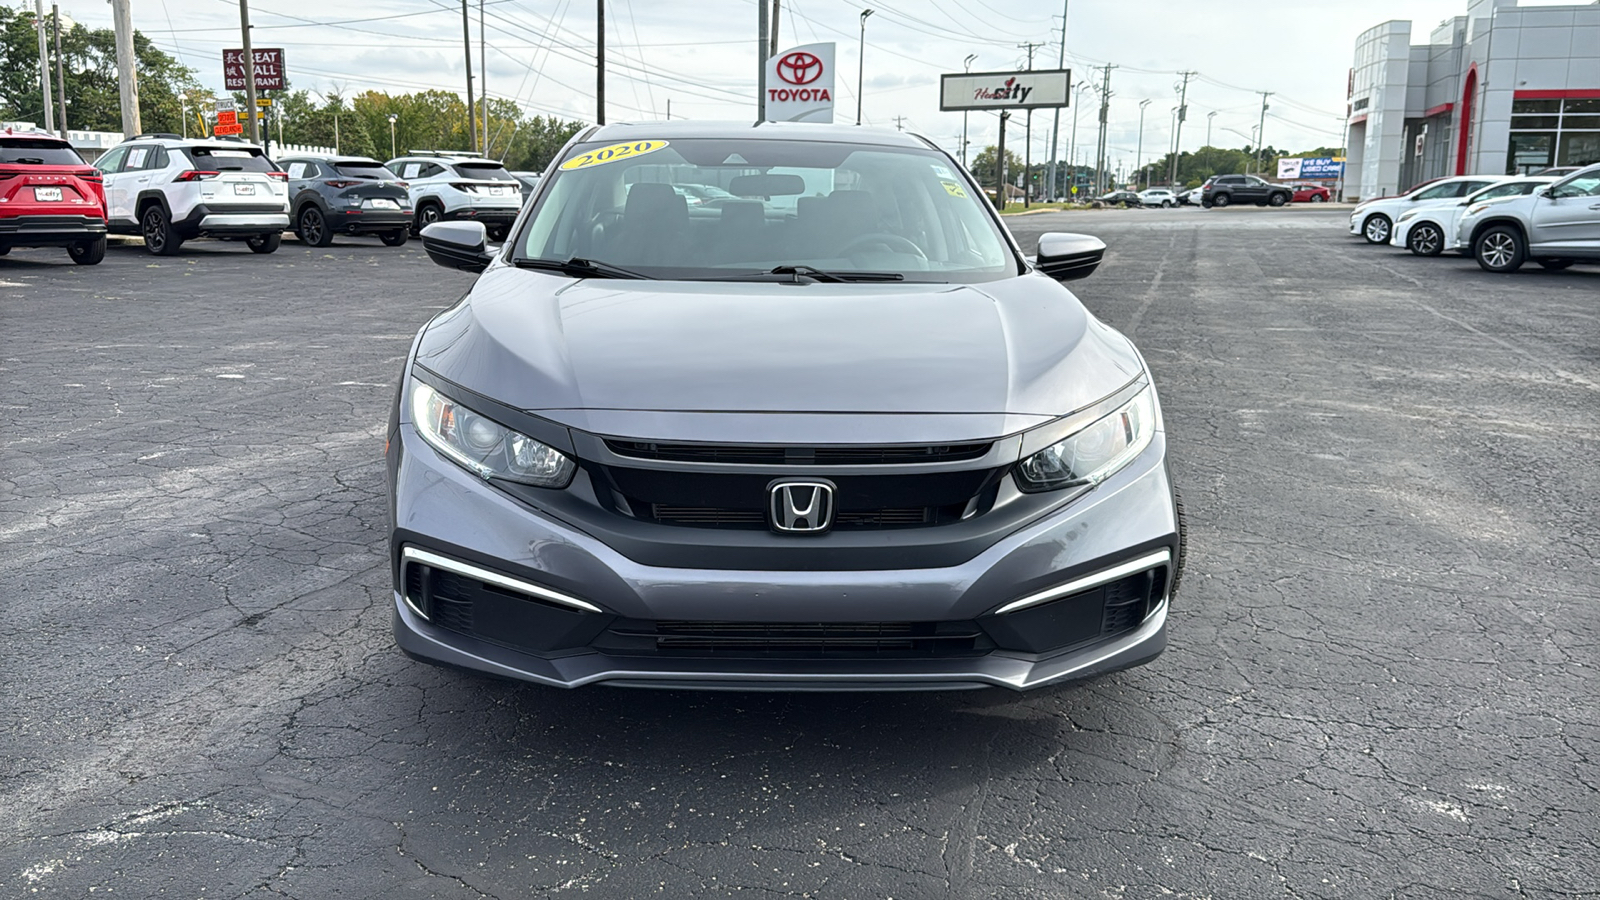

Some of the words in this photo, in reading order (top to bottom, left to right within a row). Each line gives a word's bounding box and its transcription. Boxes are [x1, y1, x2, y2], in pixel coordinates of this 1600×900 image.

[238, 52, 278, 63] GEAT
[227, 78, 280, 86] RESTRANT
[768, 88, 831, 102] TOYOTA
[217, 101, 234, 109] TRUCK
[578, 142, 652, 167] 2020
